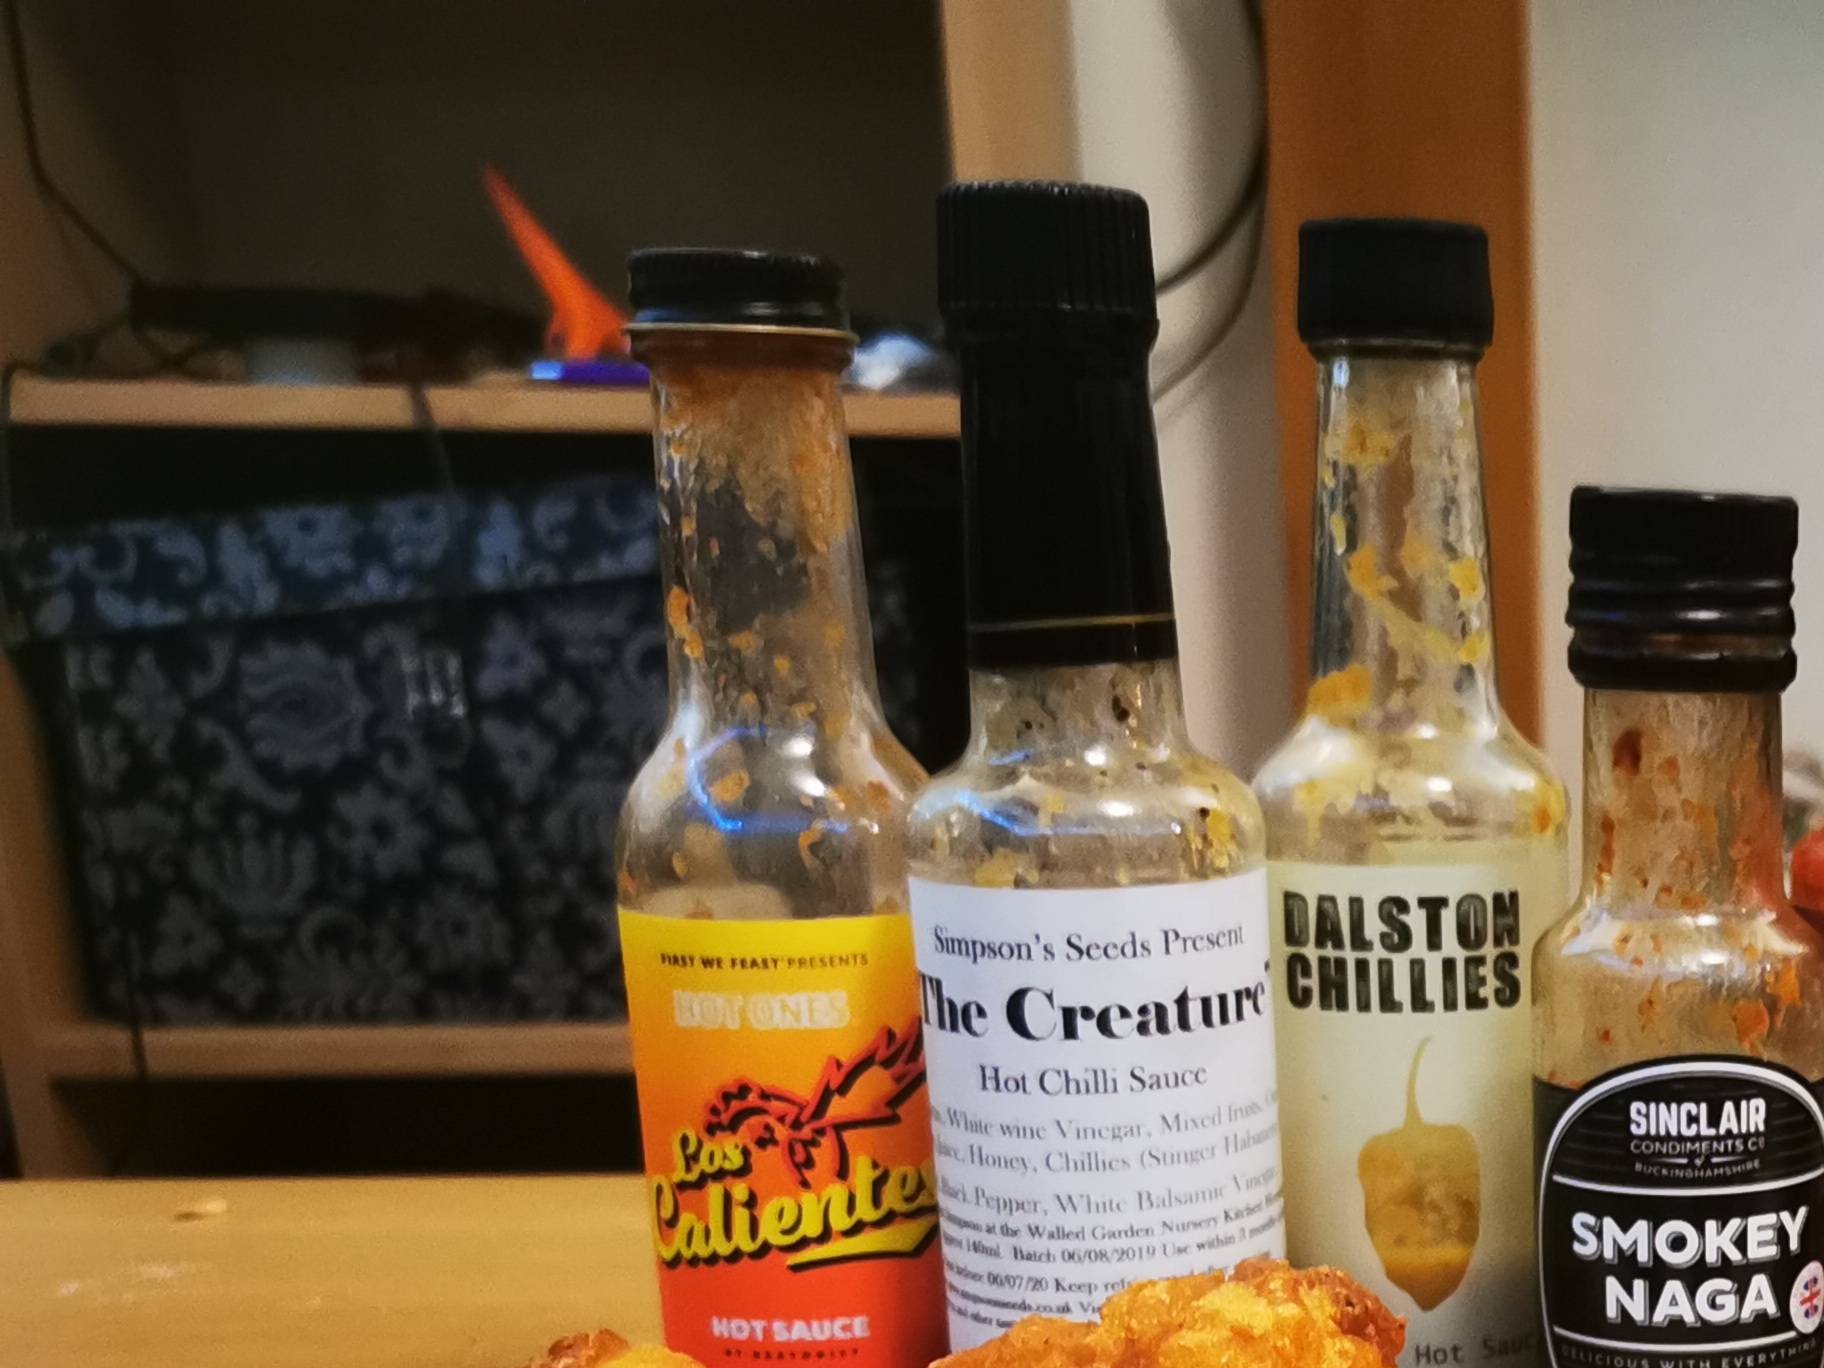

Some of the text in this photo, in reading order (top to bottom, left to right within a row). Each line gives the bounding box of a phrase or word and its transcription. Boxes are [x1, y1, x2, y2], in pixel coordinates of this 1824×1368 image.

[1283, 889, 1521, 953] DALSTON
[933, 923, 1245, 964] Simpson's Seeds Present
[660, 952, 869, 970] FIRST WE FEAST PRESENTS
[1286, 950, 1521, 1014] CHILLIES
[917, 967, 989, 1038] The
[978, 1063, 1209, 1097] Hot Chilli Sauce
[999, 1121, 1047, 1141] wine
[1160, 1106, 1223, 1136] Mixed
[1629, 1097, 1767, 1138] SINCLAIR
[673, 1126, 748, 1184] Los
[1045, 1150, 1132, 1173] Chillies
[1629, 1138, 1745, 1156] CONDIMENTS
[1633, 1158, 1762, 1180] BUCKINGHAMSHIRE
[1054, 1192, 1126, 1214] White
[1026, 1223, 1087, 1242] Walled
[1091, 1222, 1156, 1242] Garden
[1571, 1205, 1809, 1269] SMOKEY
[1054, 1275, 1099, 1297] Keep
[1604, 1272, 1780, 1328] NAGA
[711, 1315, 872, 1342] HOT SAUCE
[1414, 1343, 1466, 1368] Hot
